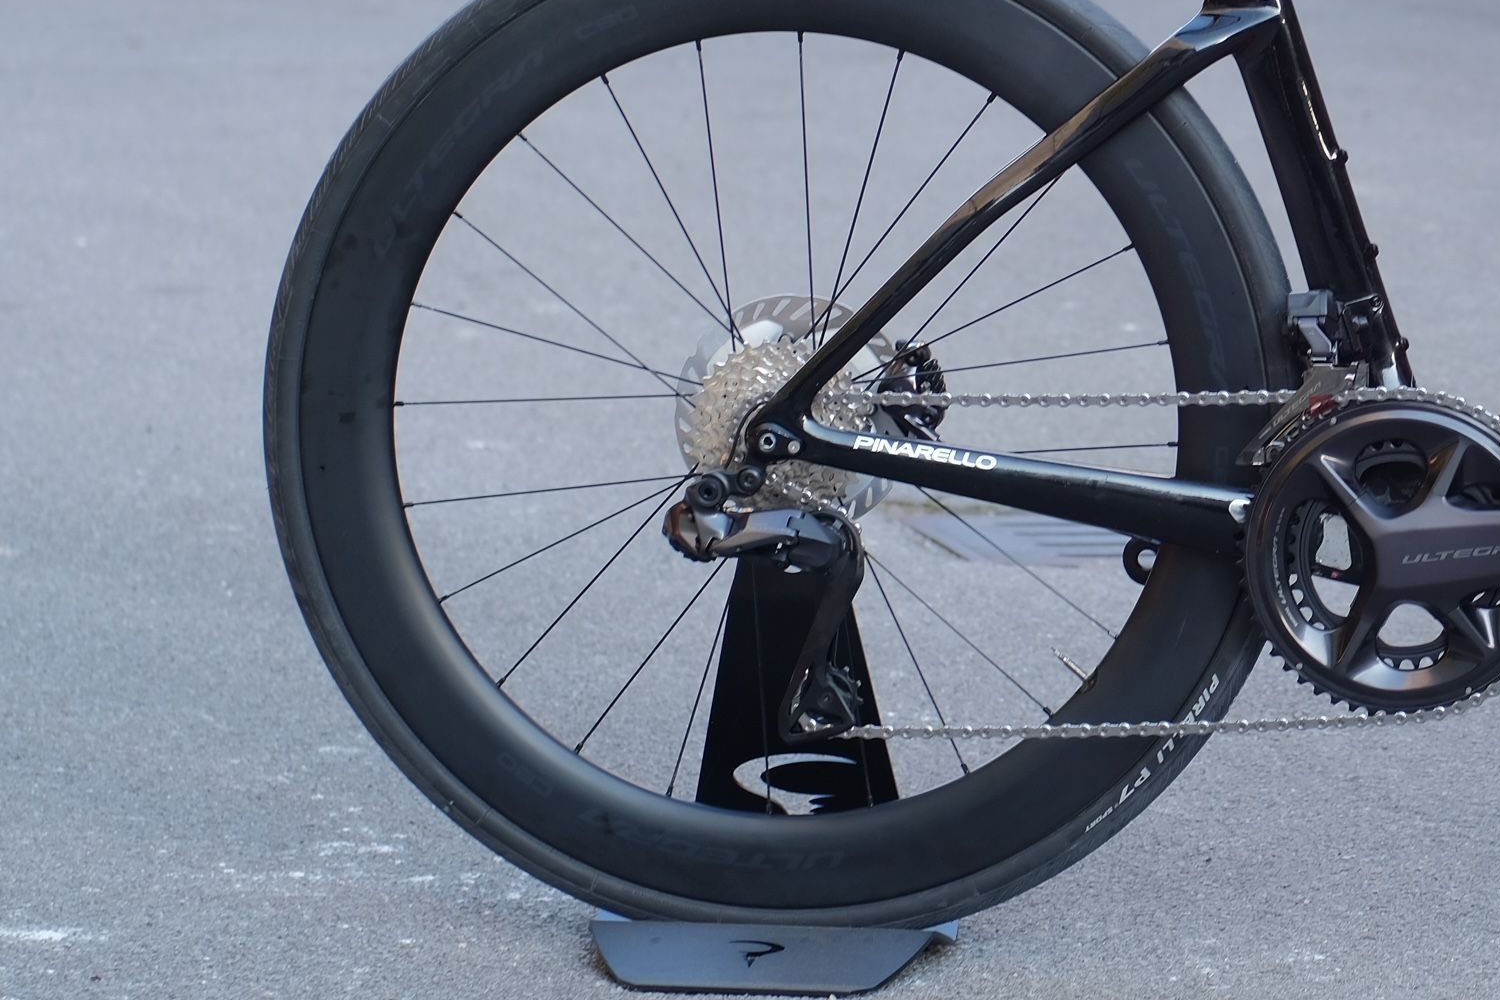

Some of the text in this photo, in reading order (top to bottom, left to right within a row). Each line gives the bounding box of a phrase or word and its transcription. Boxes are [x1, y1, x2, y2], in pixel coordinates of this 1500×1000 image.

[853, 434, 998, 471] PINARELLO
[1156, 672, 1220, 764] PIRELI
[1119, 766, 1151, 805] P7
